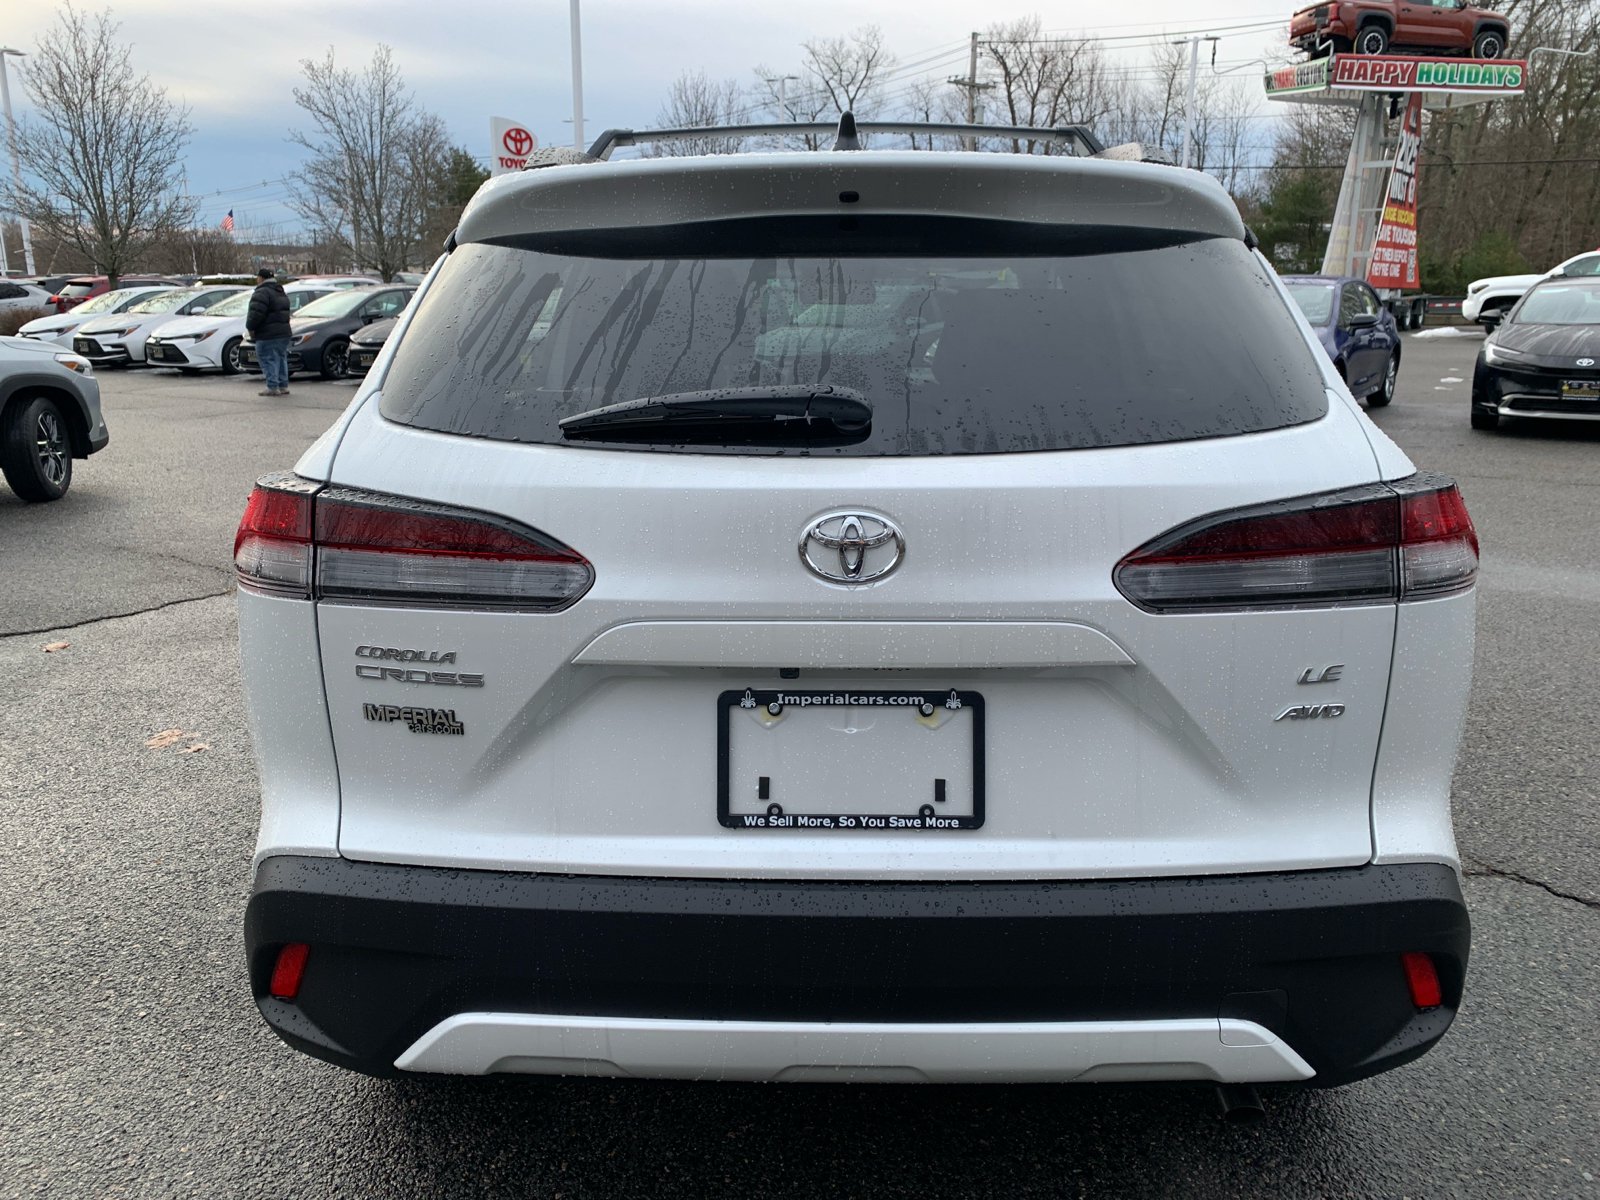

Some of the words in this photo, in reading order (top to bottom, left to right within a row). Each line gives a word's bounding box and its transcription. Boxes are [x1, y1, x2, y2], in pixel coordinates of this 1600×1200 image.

[1296, 62, 1326, 86] EVERYONE
[1336, 59, 1414, 84] HAPPY
[1416, 61, 1522, 87] HOLIDAYS
[498, 157, 527, 169] TOYO
[1390, 172, 1409, 204] MUT
[1378, 224, 1392, 242] AVE
[355, 644, 457, 664] COROLLA
[355, 664, 485, 688] CROSS
[1297, 663, 1345, 684] LE
[777, 693, 925, 708] Imperialcars.com
[362, 703, 464, 727] IMPERIAL
[1274, 703, 1345, 721] AWD
[408, 722, 465, 736] cars.com
[744, 815, 765, 828] We
[769, 815, 793, 828] Sell
[797, 815, 835, 829] More,
[839, 815, 855, 828] So
[860, 815, 885, 828] You
[889, 815, 921, 828] Save
[925, 815, 959, 828] More
